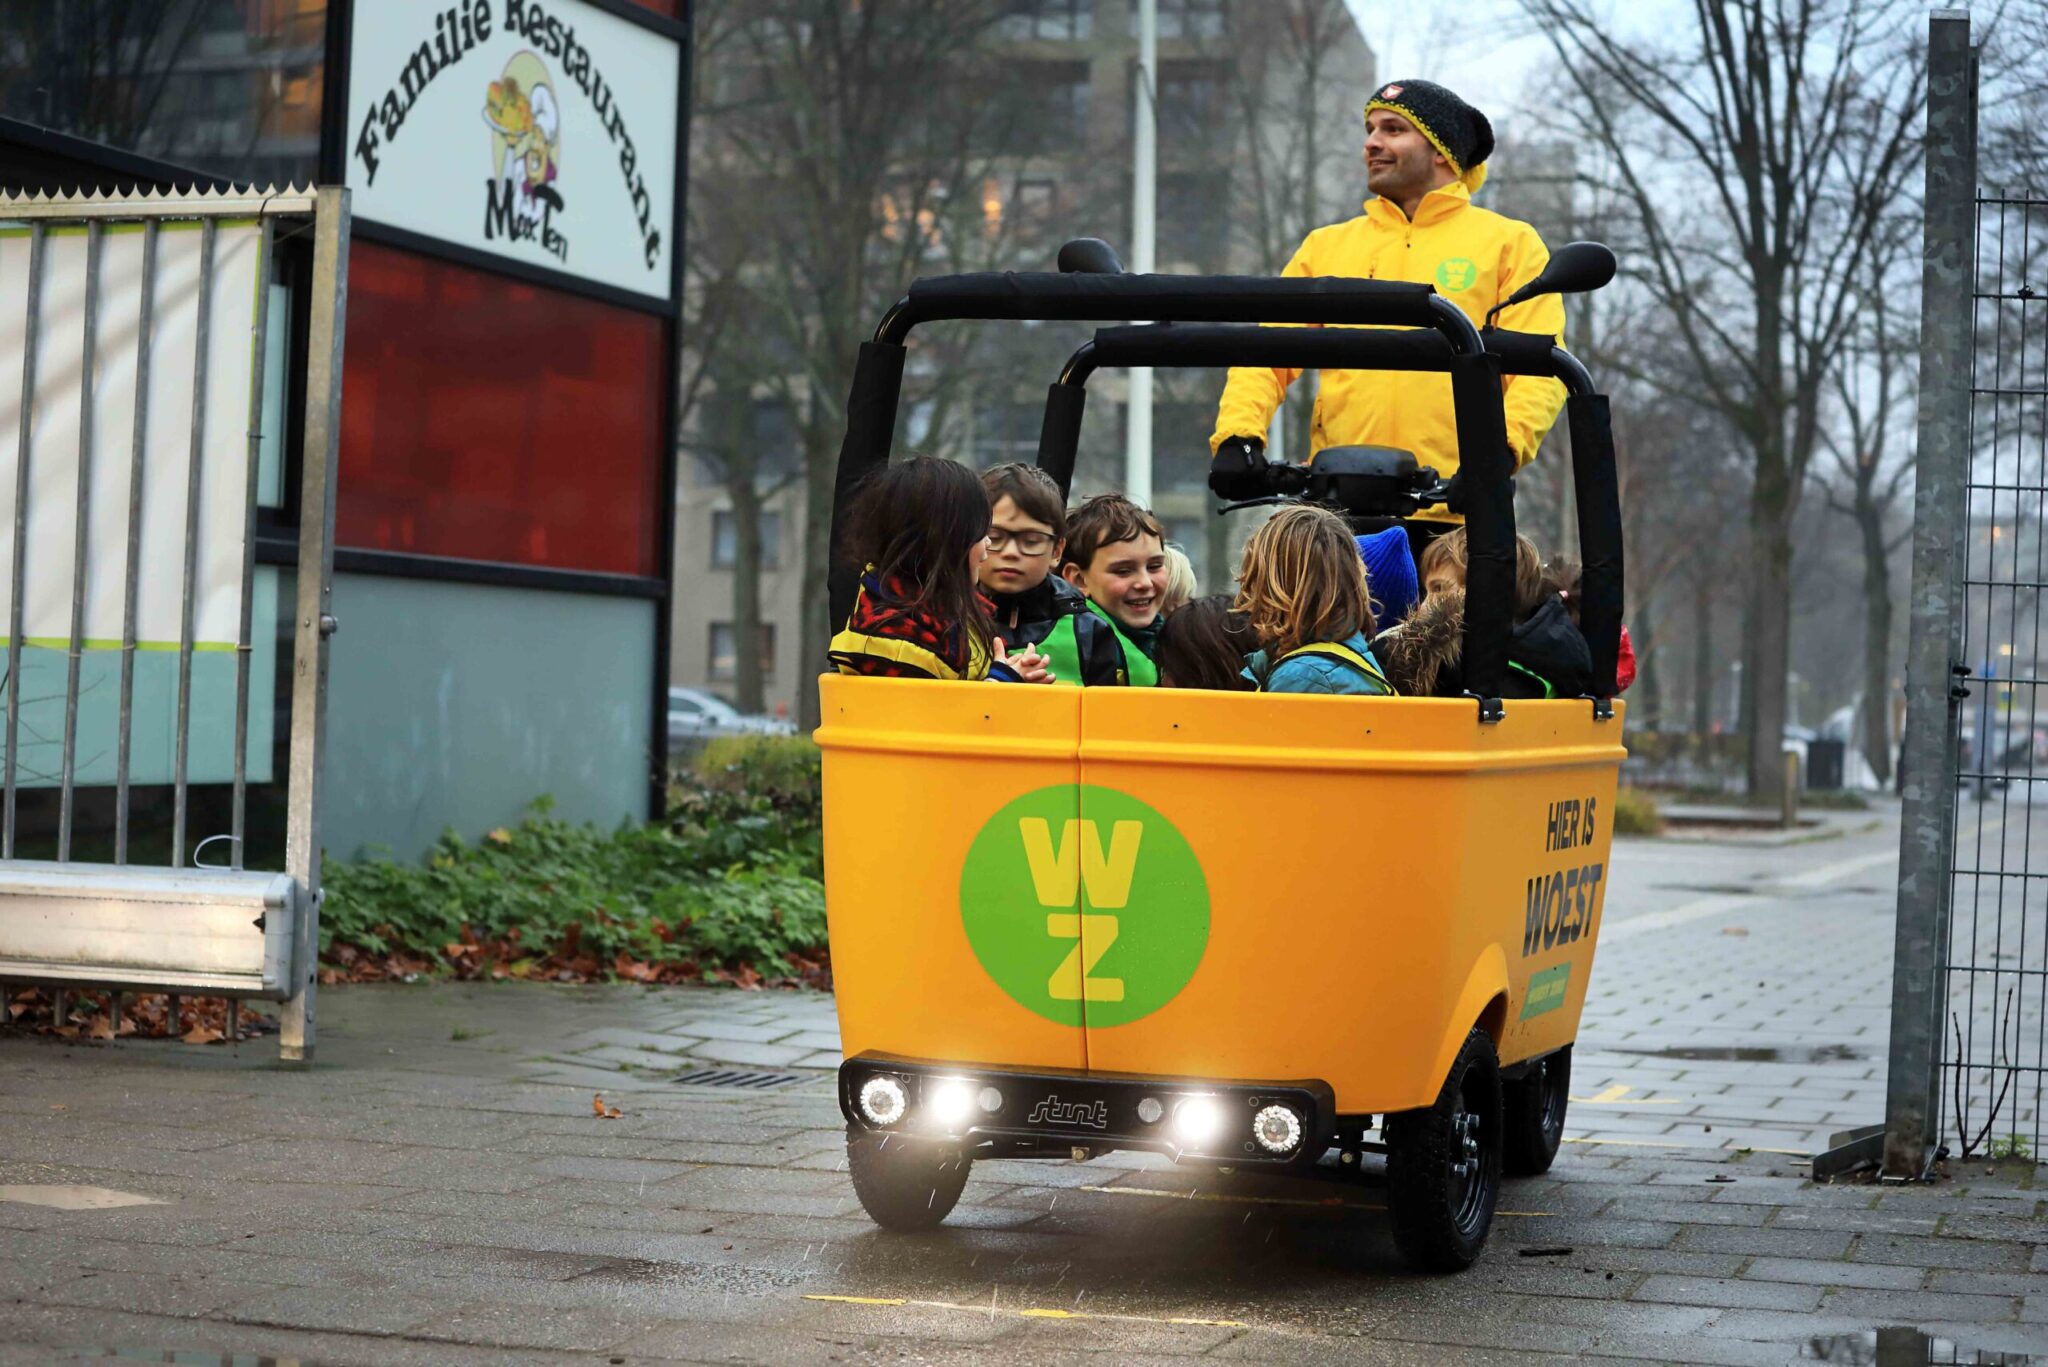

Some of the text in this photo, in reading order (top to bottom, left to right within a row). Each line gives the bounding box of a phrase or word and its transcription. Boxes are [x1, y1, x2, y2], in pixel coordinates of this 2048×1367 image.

[355, 0, 662, 270] Familie Restaurant
[1546, 796, 1597, 852] HIER IS
[1522, 863, 1603, 958] WOEST
